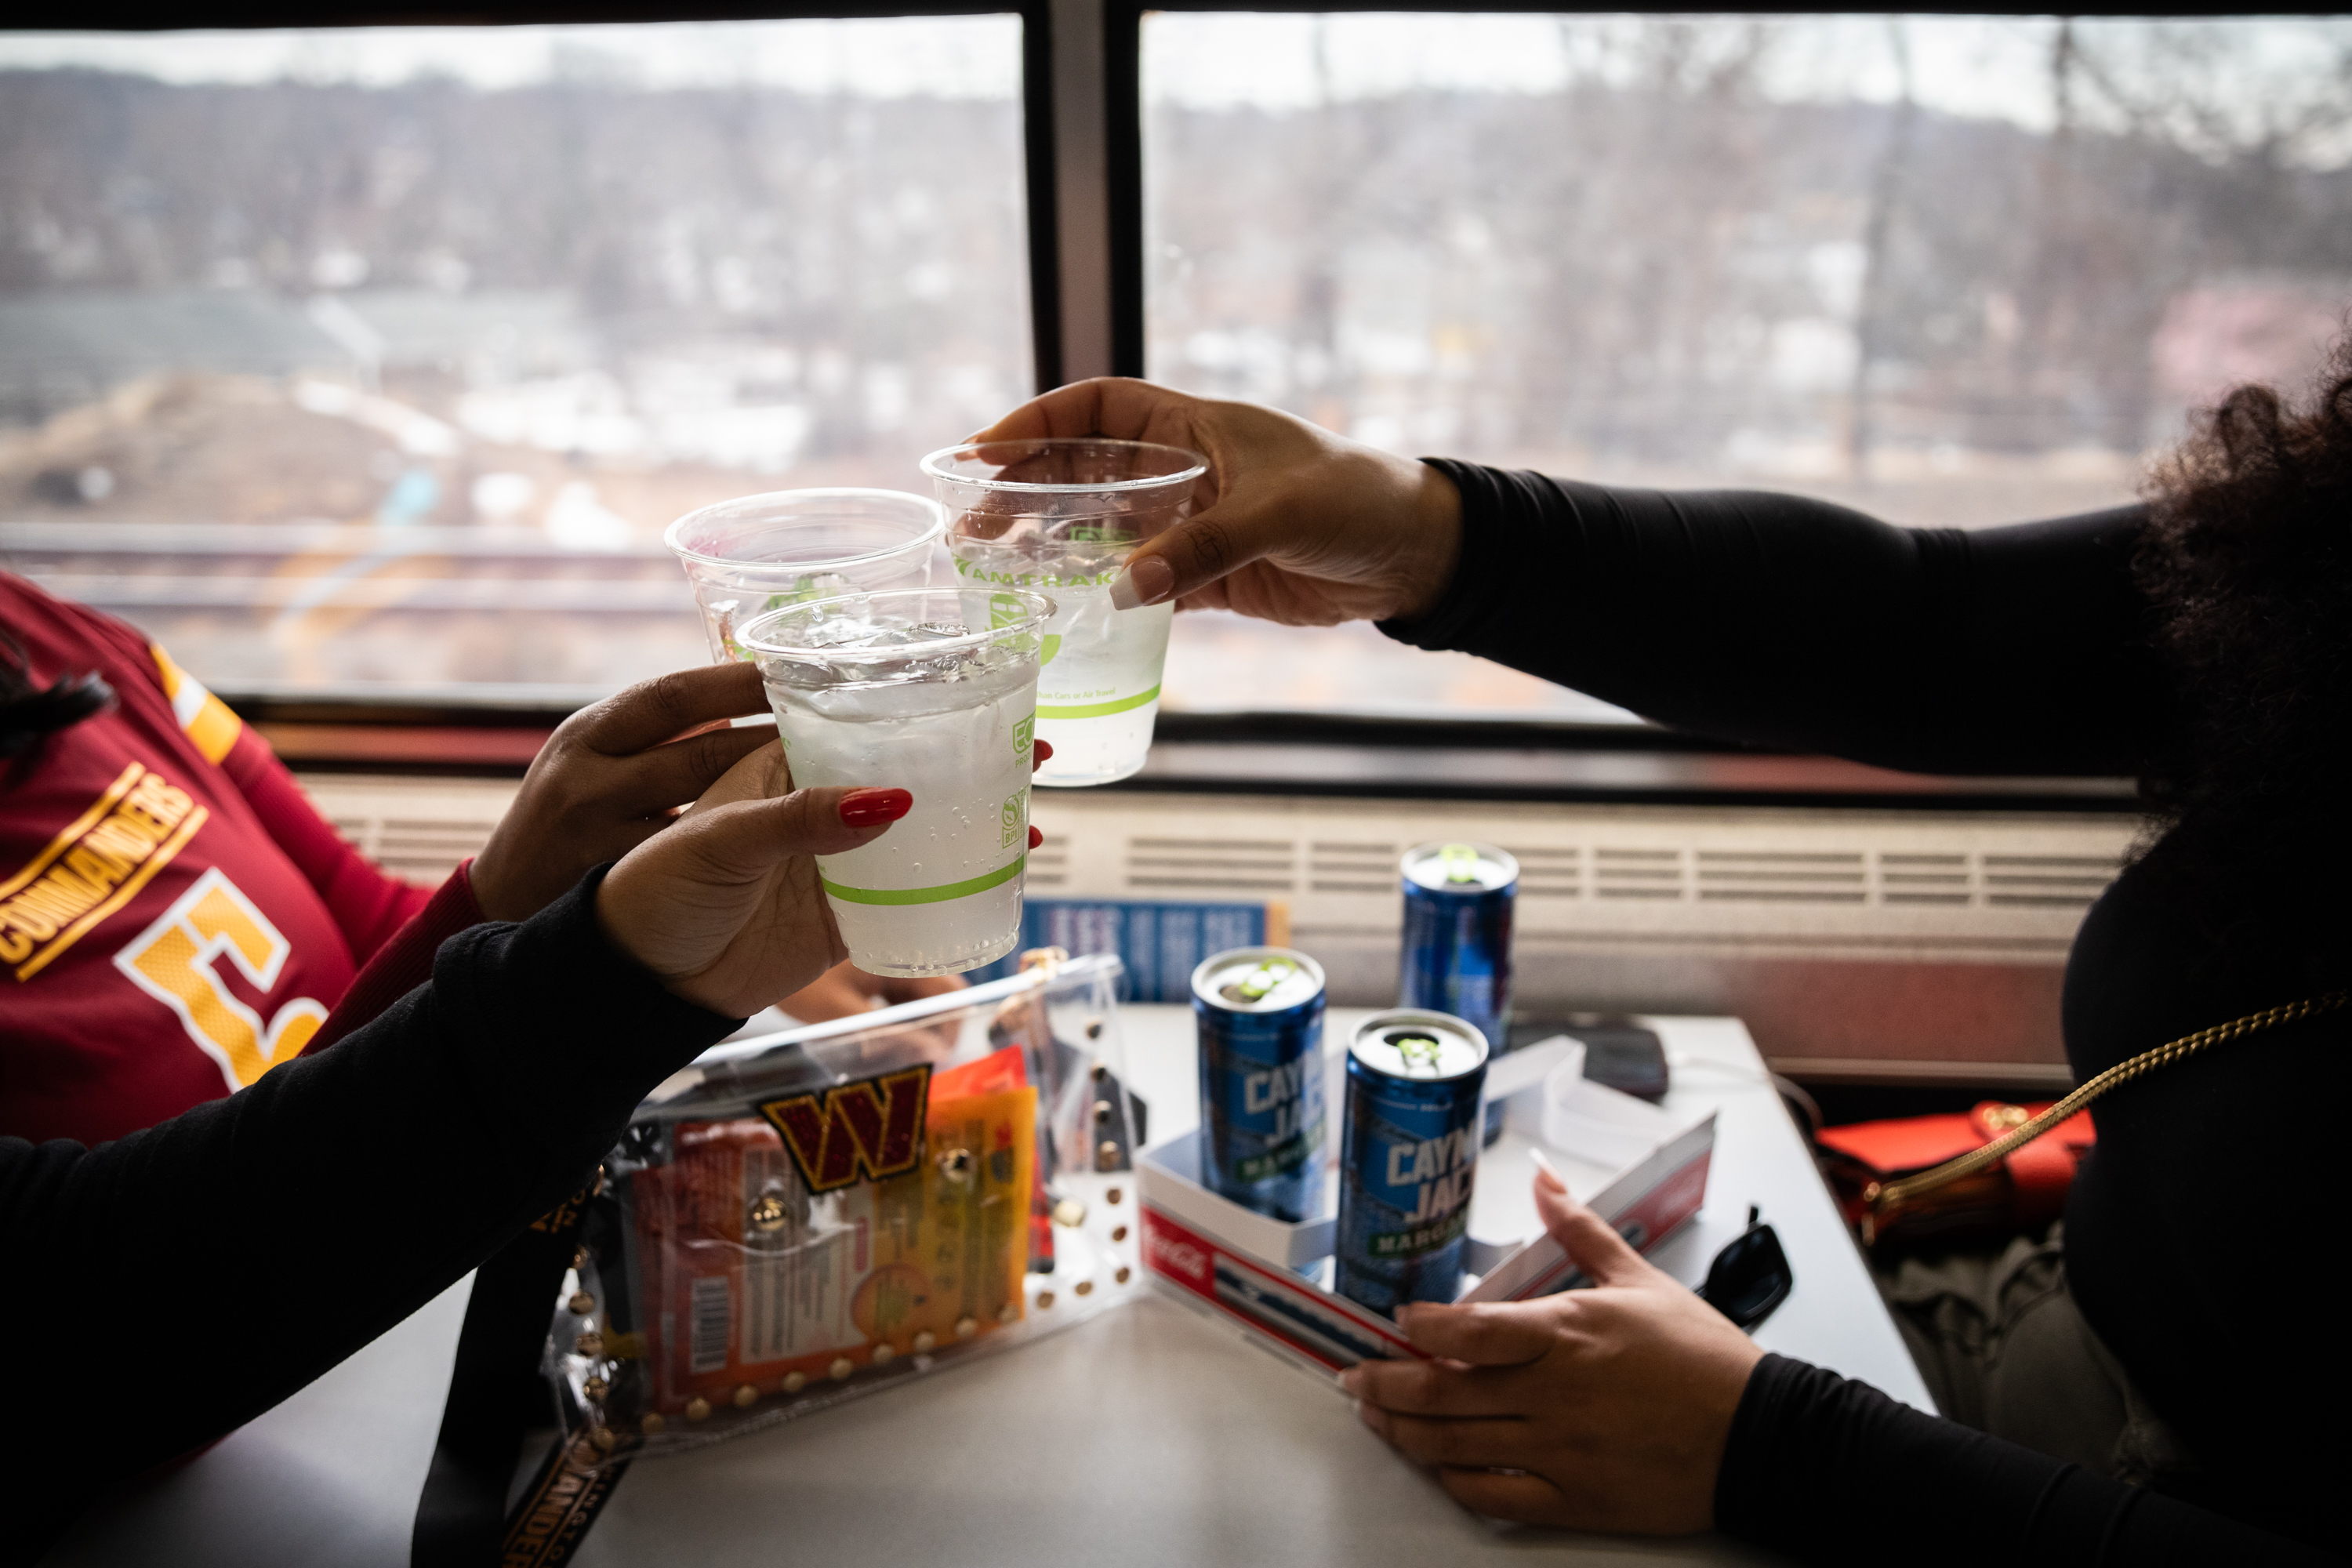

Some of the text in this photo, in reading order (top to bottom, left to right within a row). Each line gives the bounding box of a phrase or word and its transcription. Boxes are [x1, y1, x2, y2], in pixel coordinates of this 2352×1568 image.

[972, 568, 1115, 586] AMTRAK
[1096, 687, 1116, 696] Travel
[1005, 828, 1018, 844] BPI
